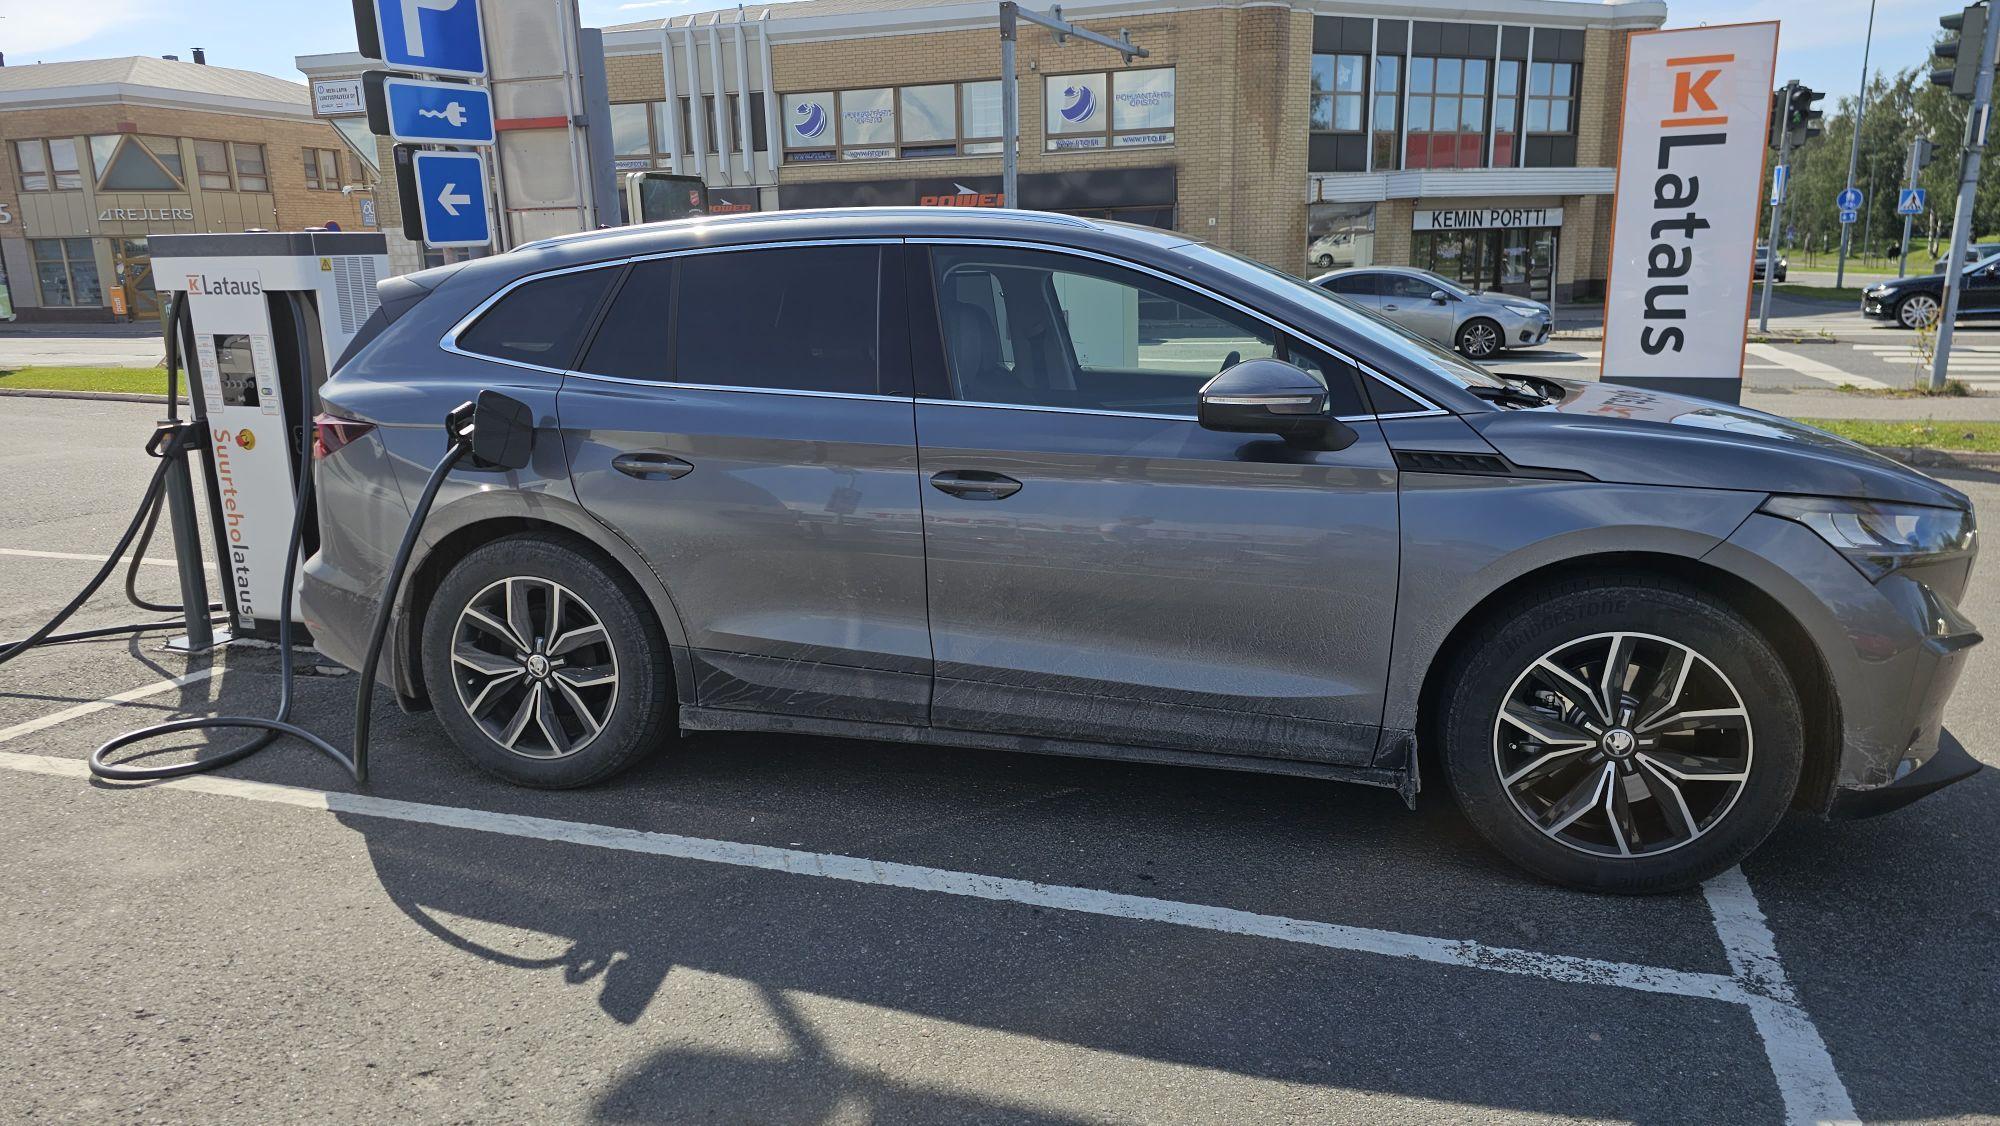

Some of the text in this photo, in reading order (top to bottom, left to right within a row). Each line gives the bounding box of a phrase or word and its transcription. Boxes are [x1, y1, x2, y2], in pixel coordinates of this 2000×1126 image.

[115, 208, 194, 221] REJLERS
[1432, 209, 1547, 228] KEMIN PORTTI
[1641, 133, 1727, 355] Lataus
[202, 275, 261, 295] Lataus
[214, 429, 254, 615] Suurteholataus
